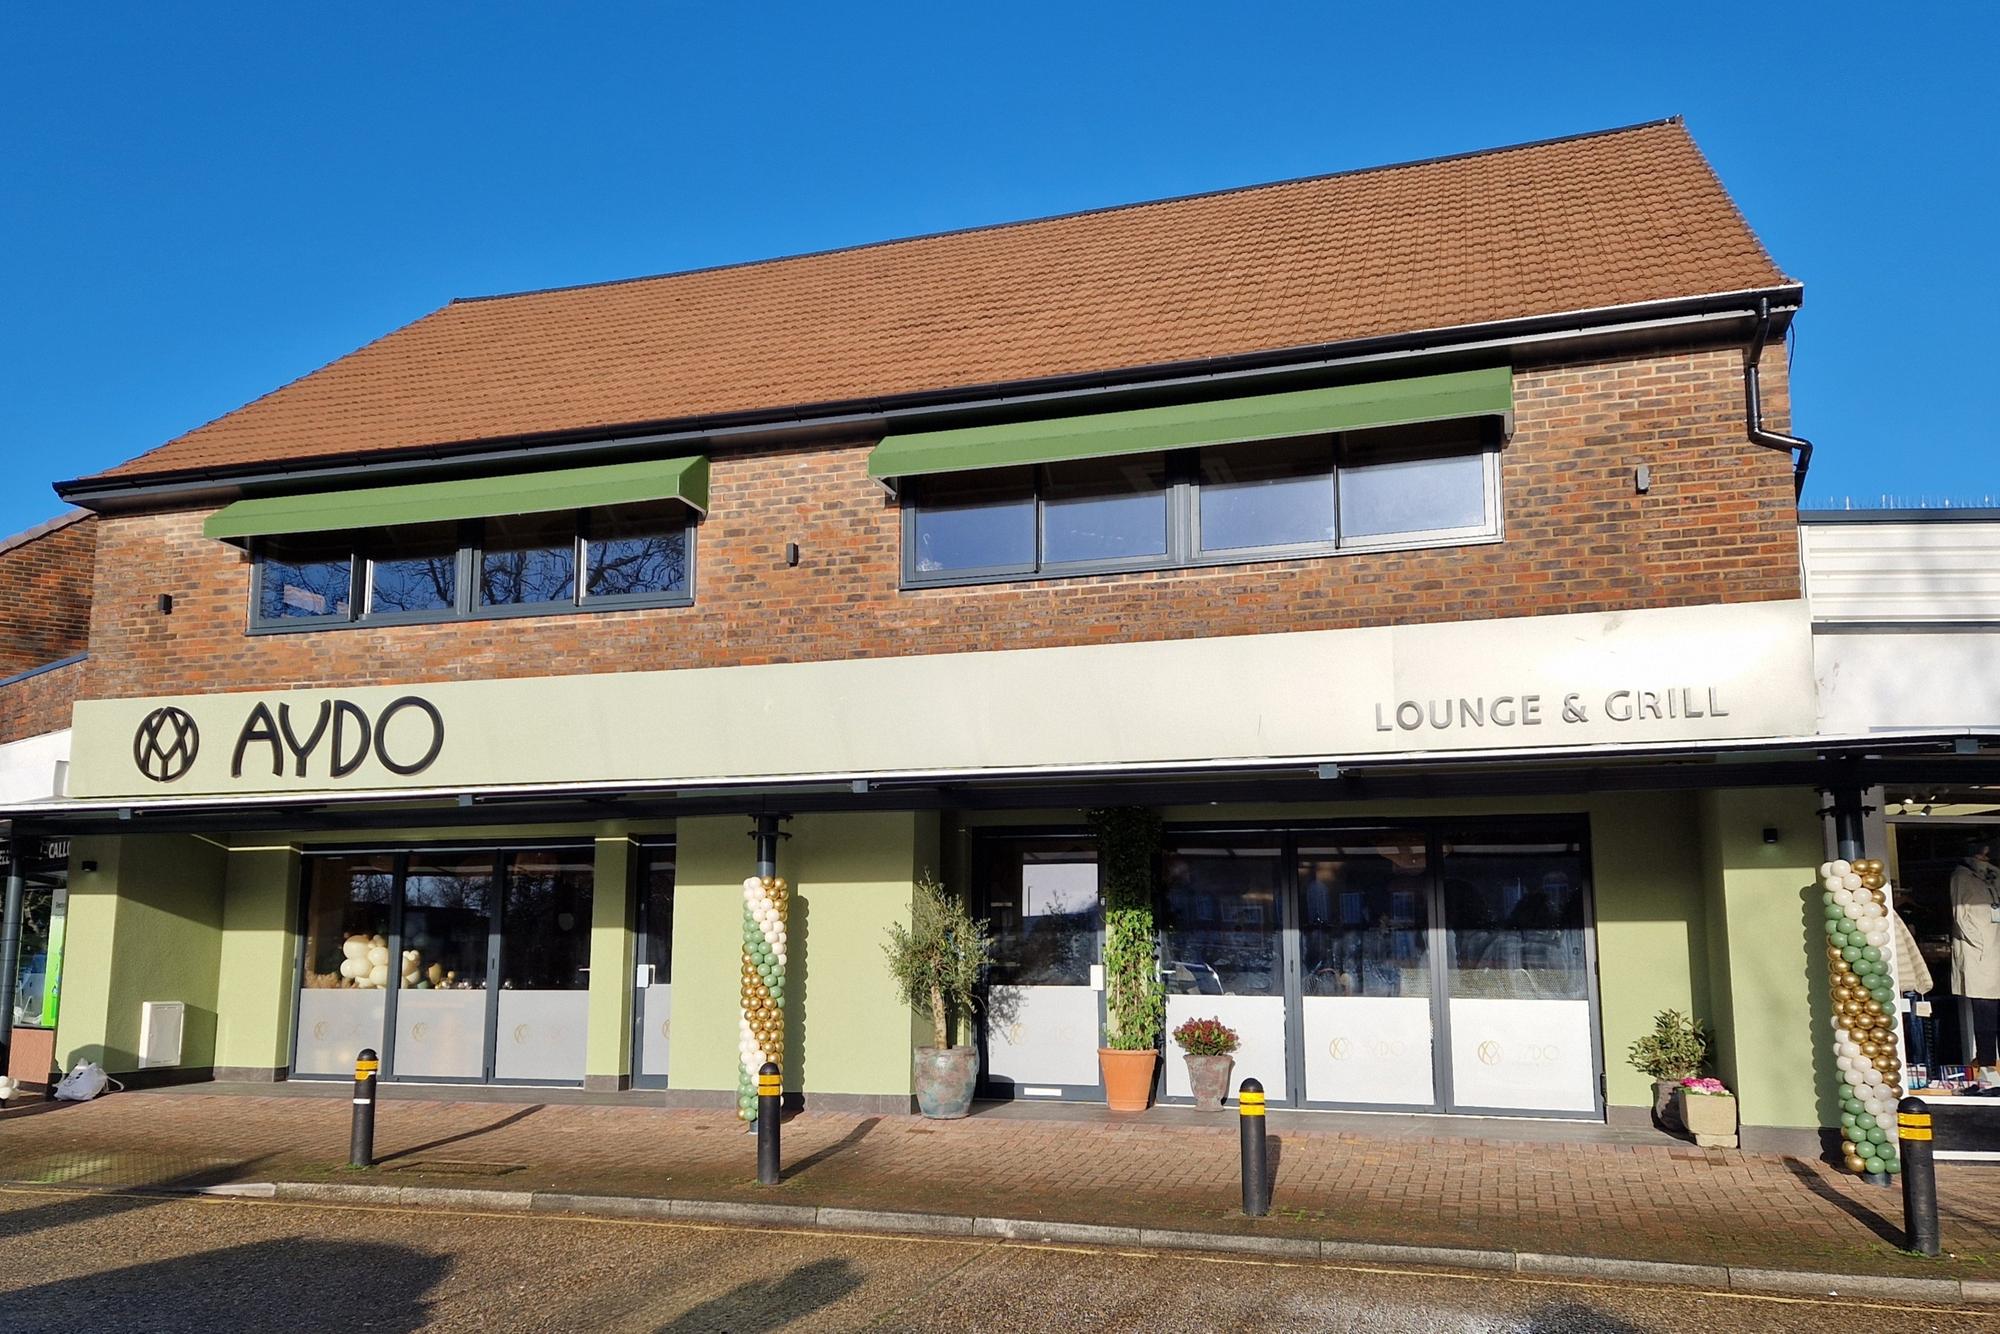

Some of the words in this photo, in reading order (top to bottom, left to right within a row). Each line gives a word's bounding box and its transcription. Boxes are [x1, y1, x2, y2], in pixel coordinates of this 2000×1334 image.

[231, 695, 444, 778] AYDO
[1375, 694, 1542, 732] LOUNGE
[1561, 692, 1590, 723] &
[1604, 686, 1730, 722] GRILL
